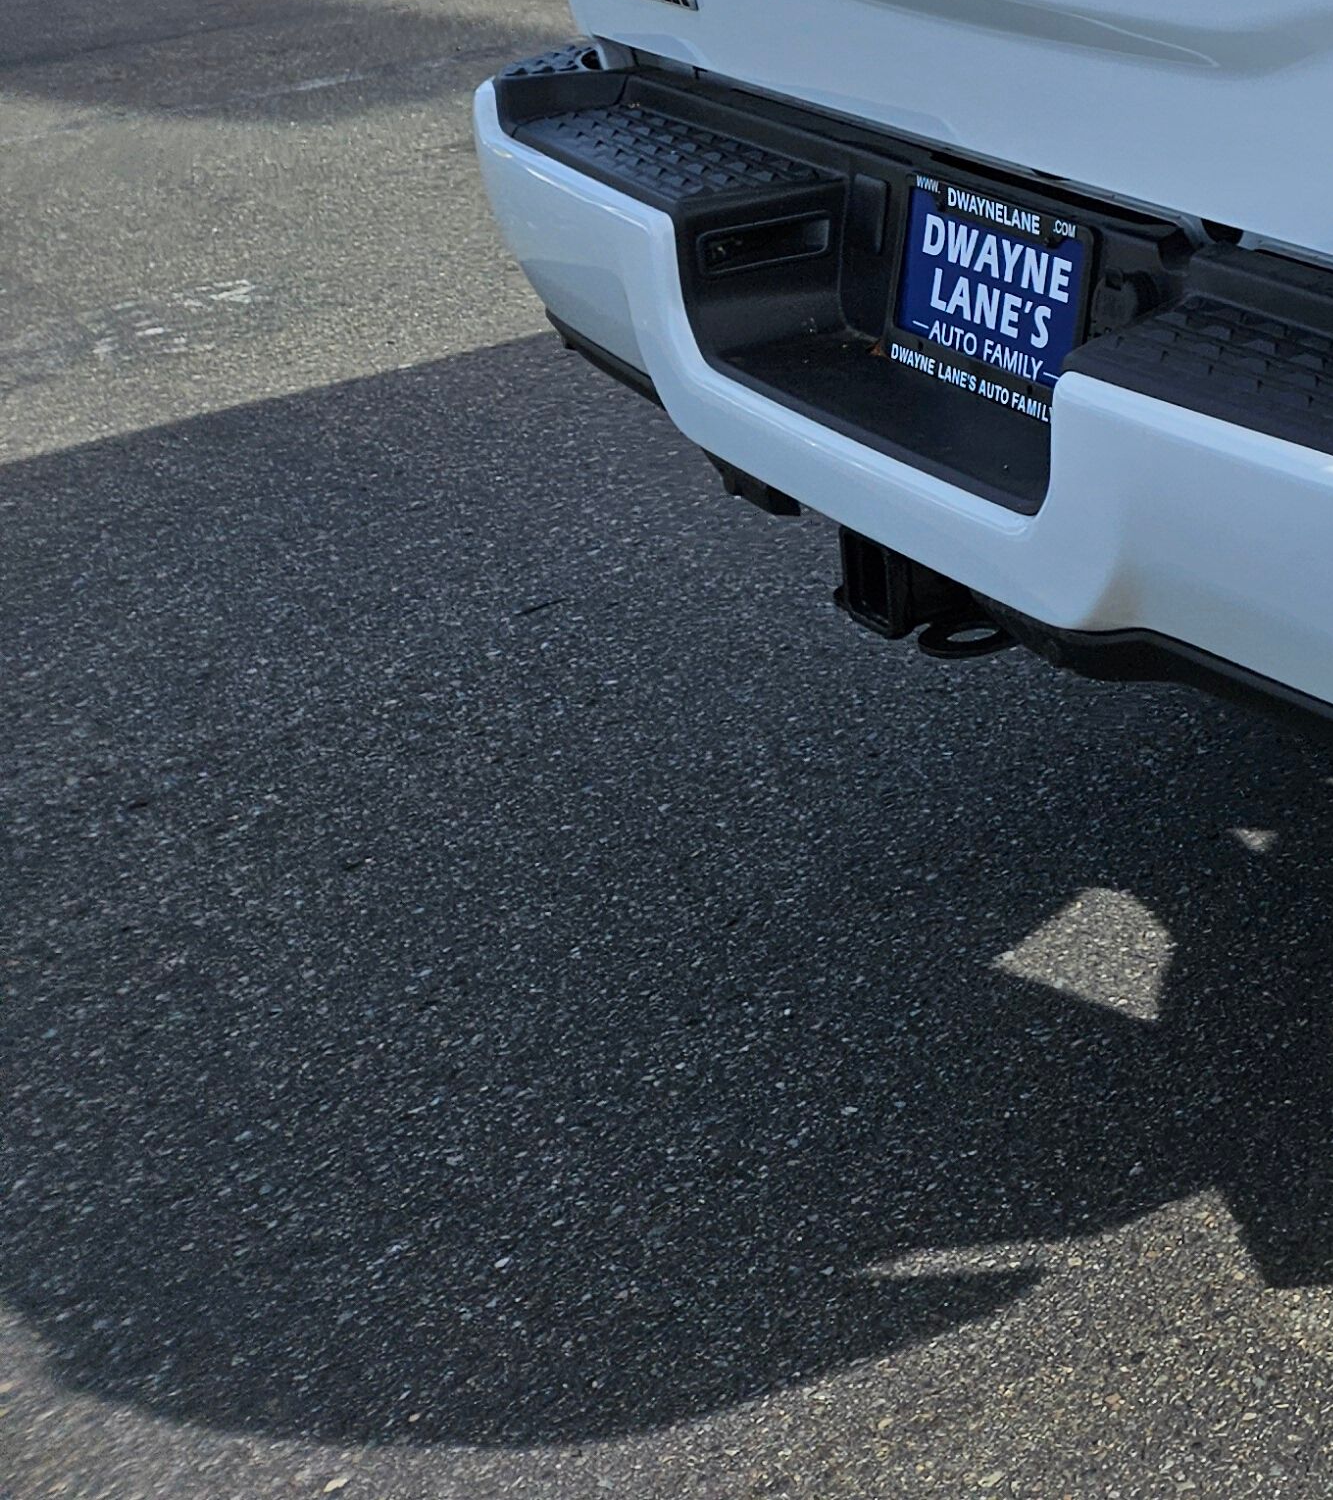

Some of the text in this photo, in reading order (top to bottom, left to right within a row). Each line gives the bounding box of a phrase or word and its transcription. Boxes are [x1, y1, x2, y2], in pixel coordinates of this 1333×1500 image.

[947, 186, 1041, 236] DWAYNELANE
[921, 213, 1073, 304] DWAYNE
[930, 267, 1052, 350] LANE'S
[890, 343, 1053, 423] DWAYNE LANE'S AUTO FAMIL
[928, 320, 1044, 382] AUTO FAMILY
